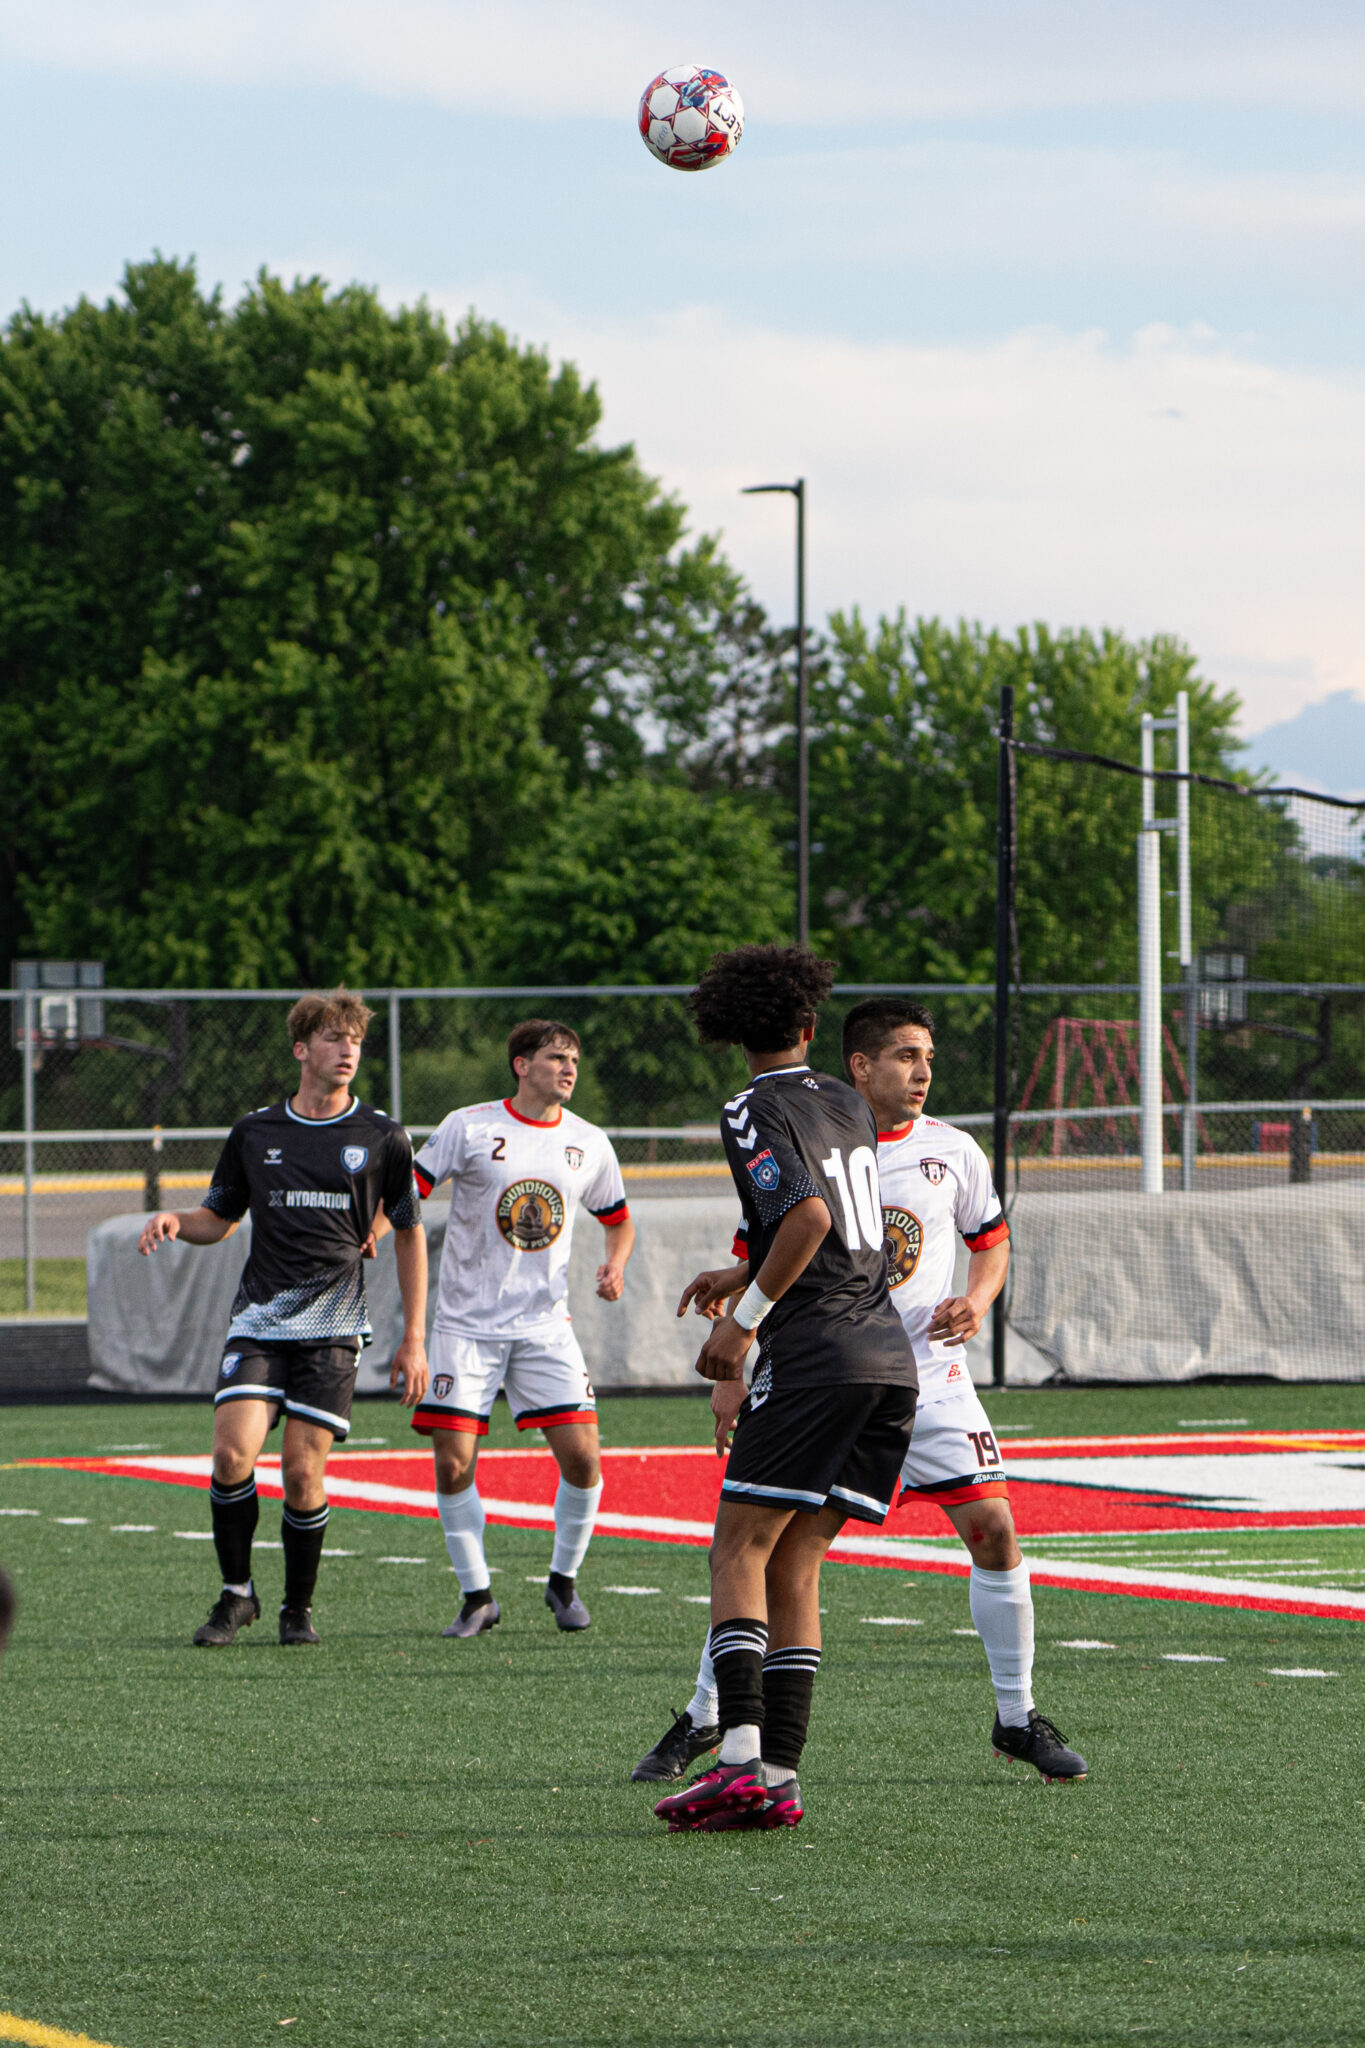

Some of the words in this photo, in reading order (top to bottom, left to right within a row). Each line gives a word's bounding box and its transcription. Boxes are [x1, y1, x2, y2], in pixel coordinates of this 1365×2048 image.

[713, 103, 742, 146] ELECT
[491, 1137, 507, 1161] 2
[286, 1190, 351, 1210] HYDRATION
[496, 1180, 564, 1226] ROUNDHOUSE
[821, 1145, 884, 1252] 10
[530, 1235, 551, 1249] PUB
[883, 1209, 921, 1257] HOUSE
[887, 1271, 904, 1286] UB
[967, 1431, 1000, 1468] 19
